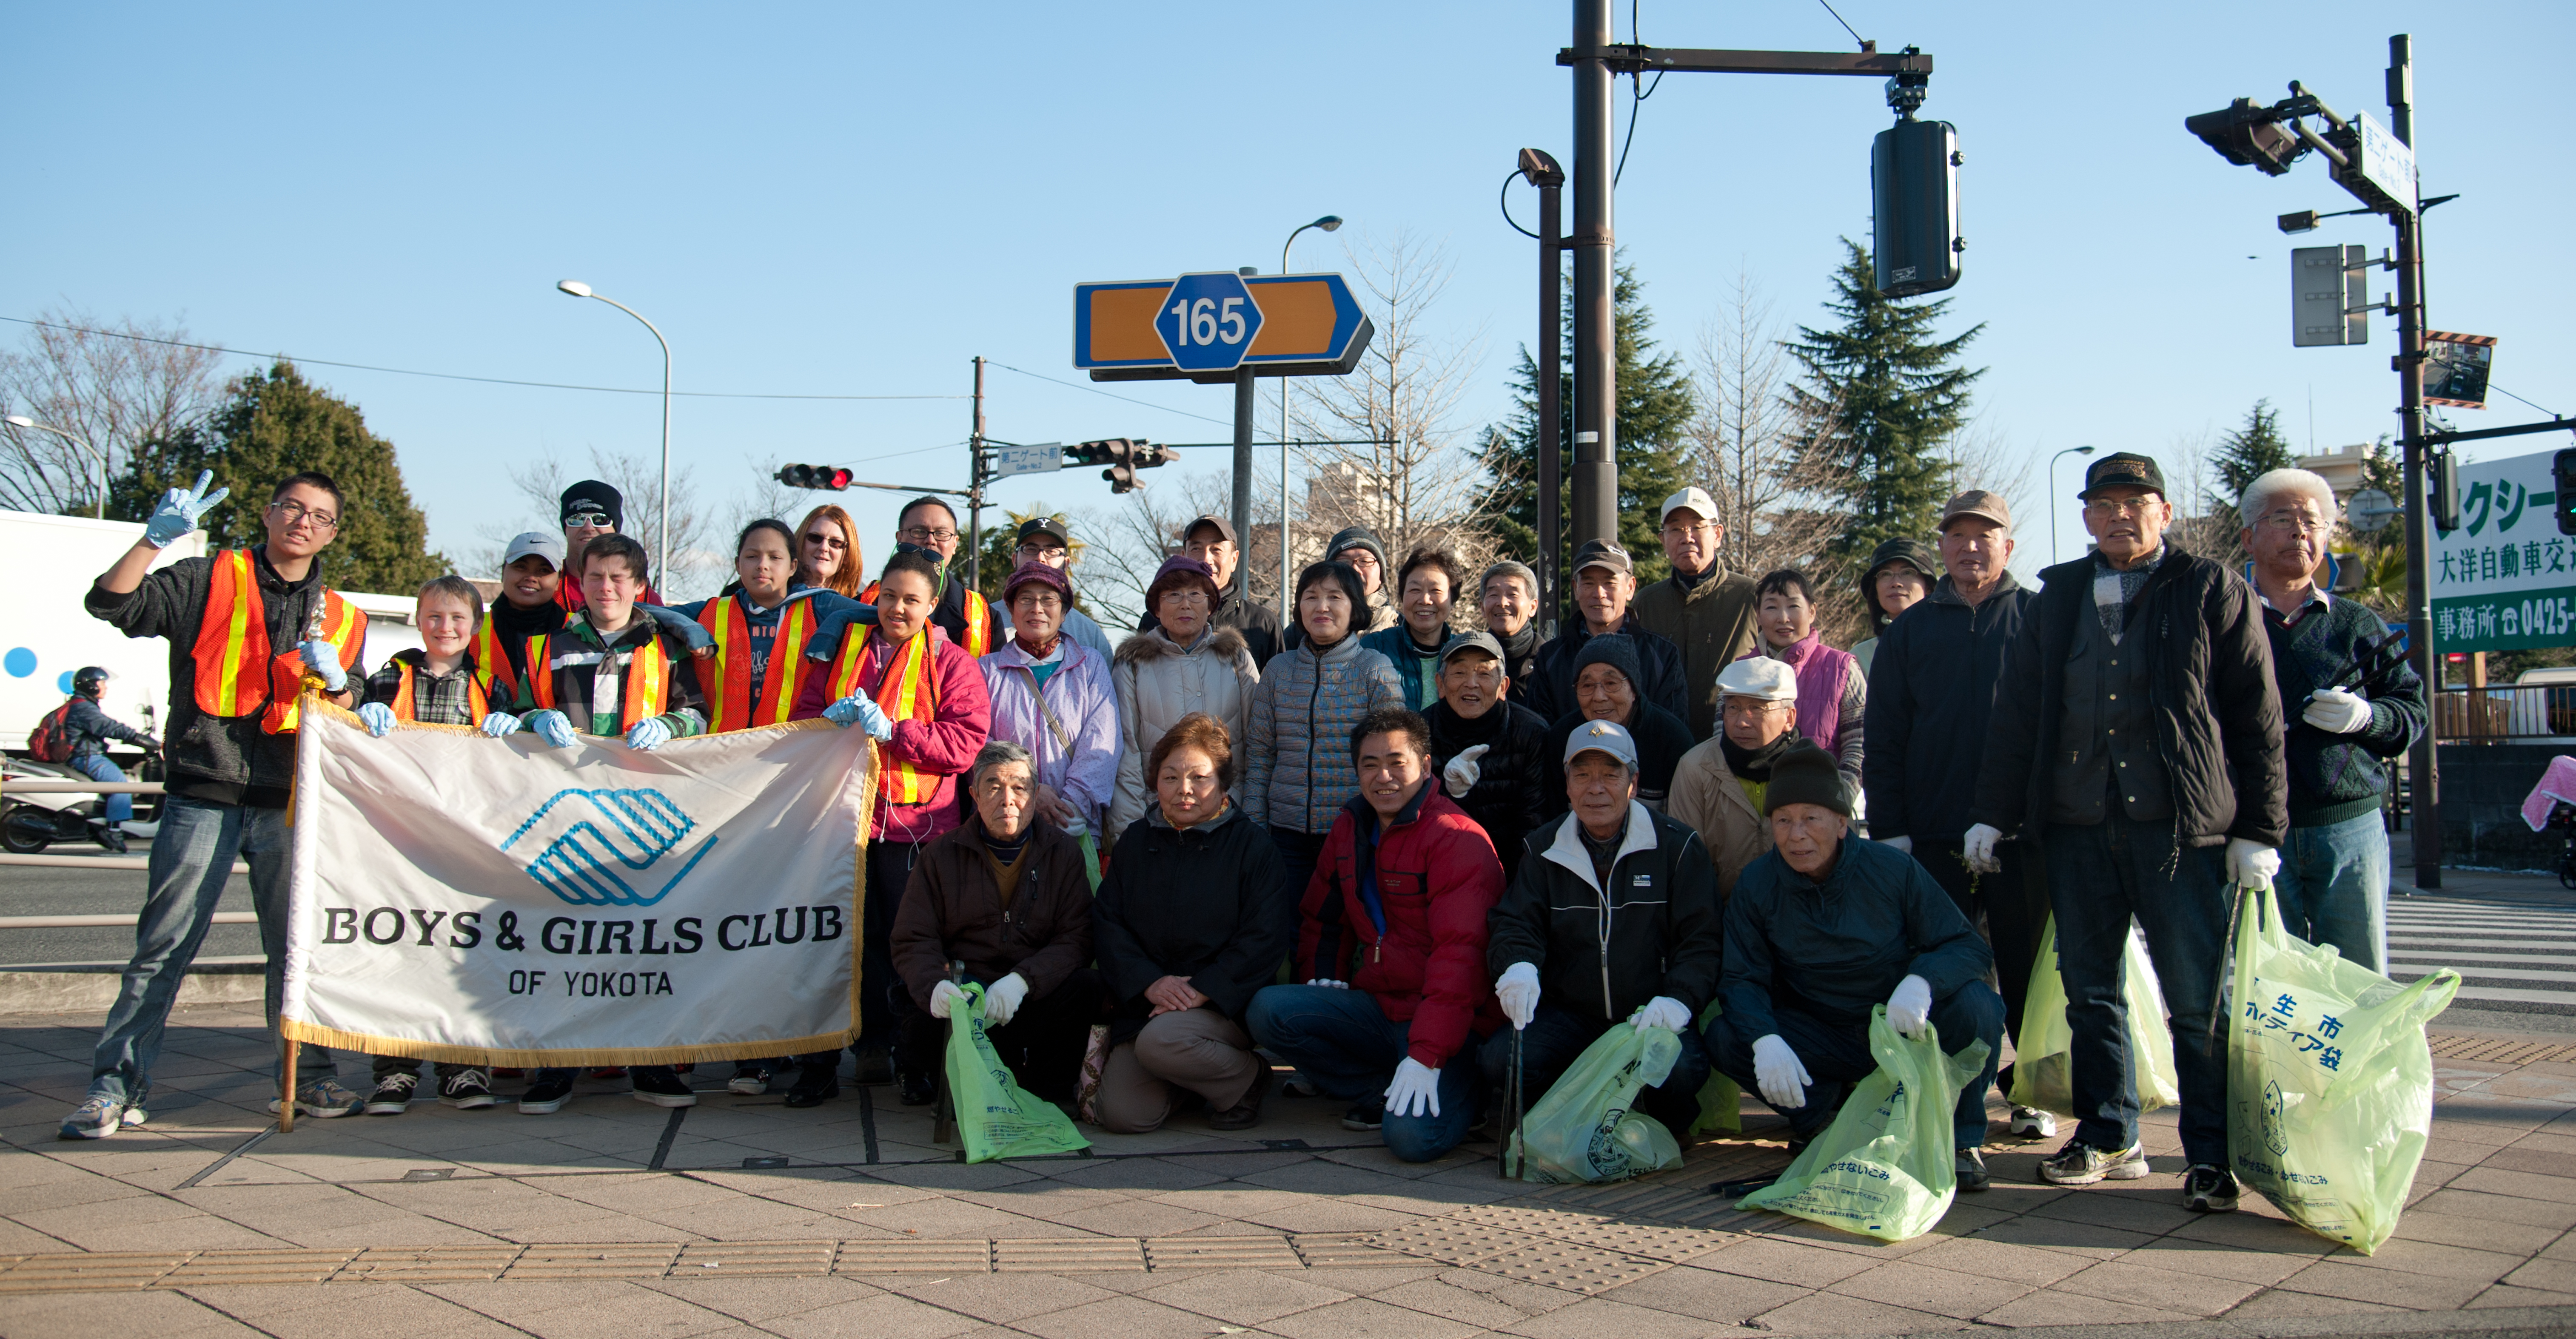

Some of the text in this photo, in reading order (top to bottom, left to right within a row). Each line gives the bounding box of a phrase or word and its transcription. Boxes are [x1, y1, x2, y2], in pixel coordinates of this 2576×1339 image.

[1171, 297, 1246, 346] 165
[1001, 447, 1057, 464] 第二ゲート前
[2436, 479, 2556, 540] クシー
[2437, 597, 2576, 641] 事務所 0425-
[322, 905, 843, 955] BOYS & GIRLS CLUB
[510, 969, 673, 997] OF YOKOTA
